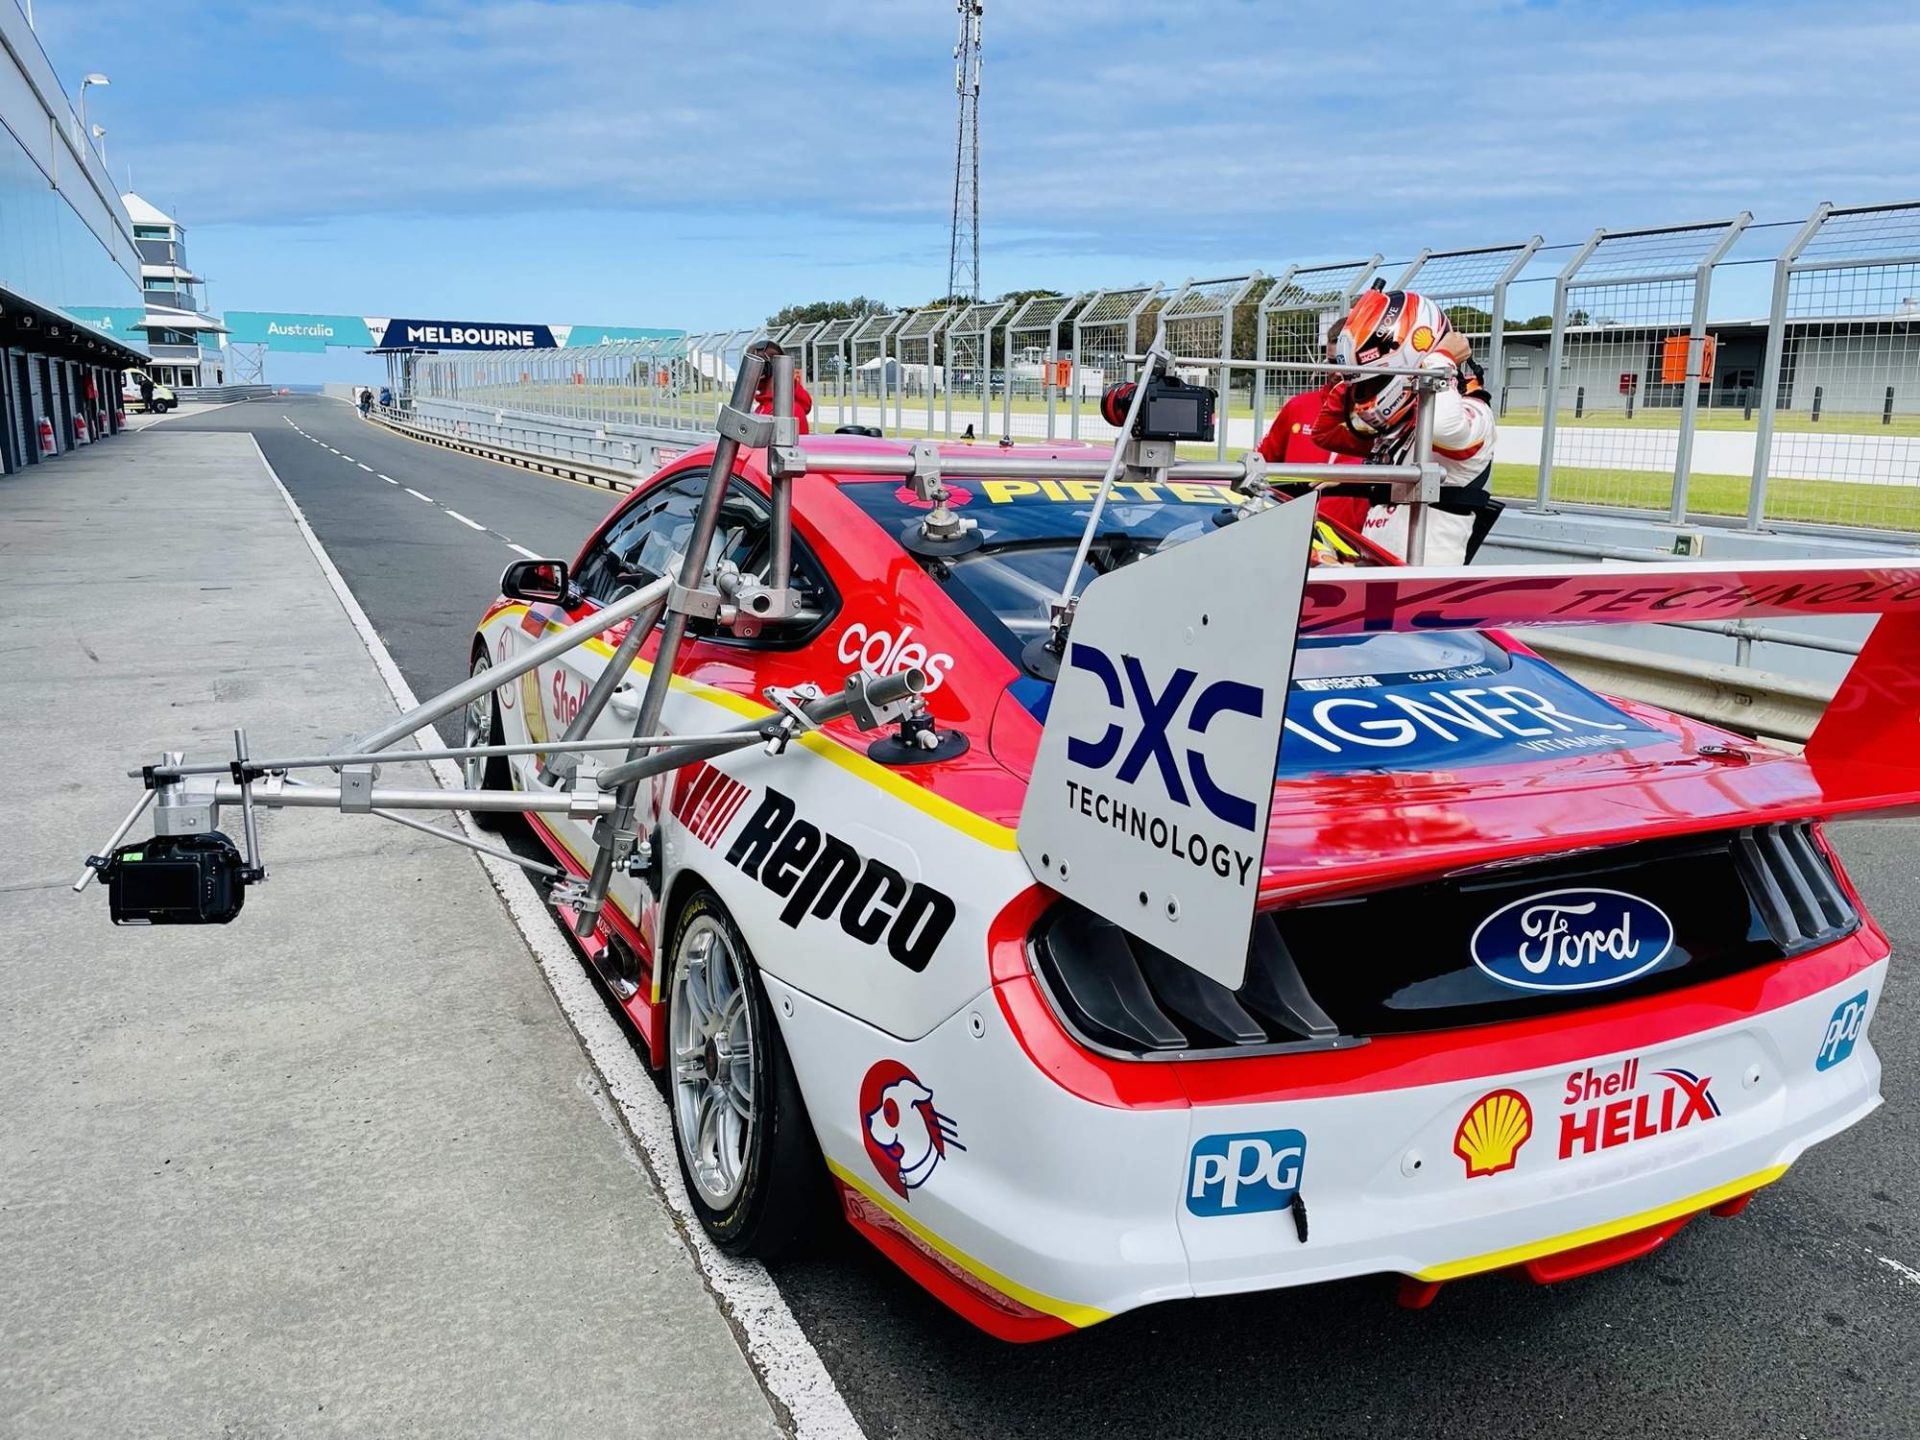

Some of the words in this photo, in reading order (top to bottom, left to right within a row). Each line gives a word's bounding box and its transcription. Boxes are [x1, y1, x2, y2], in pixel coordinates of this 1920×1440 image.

[24, 316, 32, 327] 9
[51, 326, 59, 336] 8
[71, 335, 78, 343] 7
[268, 321, 334, 337] Australia
[407, 326, 535, 347] MELBOURNE
[838, 623, 954, 693] coles
[1068, 642, 1264, 832] DXC
[1516, 735, 1627, 752] VITAMINS
[1066, 780, 1254, 887] TECHNOLOGY
[724, 785, 957, 973] Repco
[1519, 901, 1640, 974] Ford
[1563, 1057, 1640, 1105] Shell
[1559, 1074, 1719, 1160] HELIX
[1192, 1139, 1302, 1208] PPG
